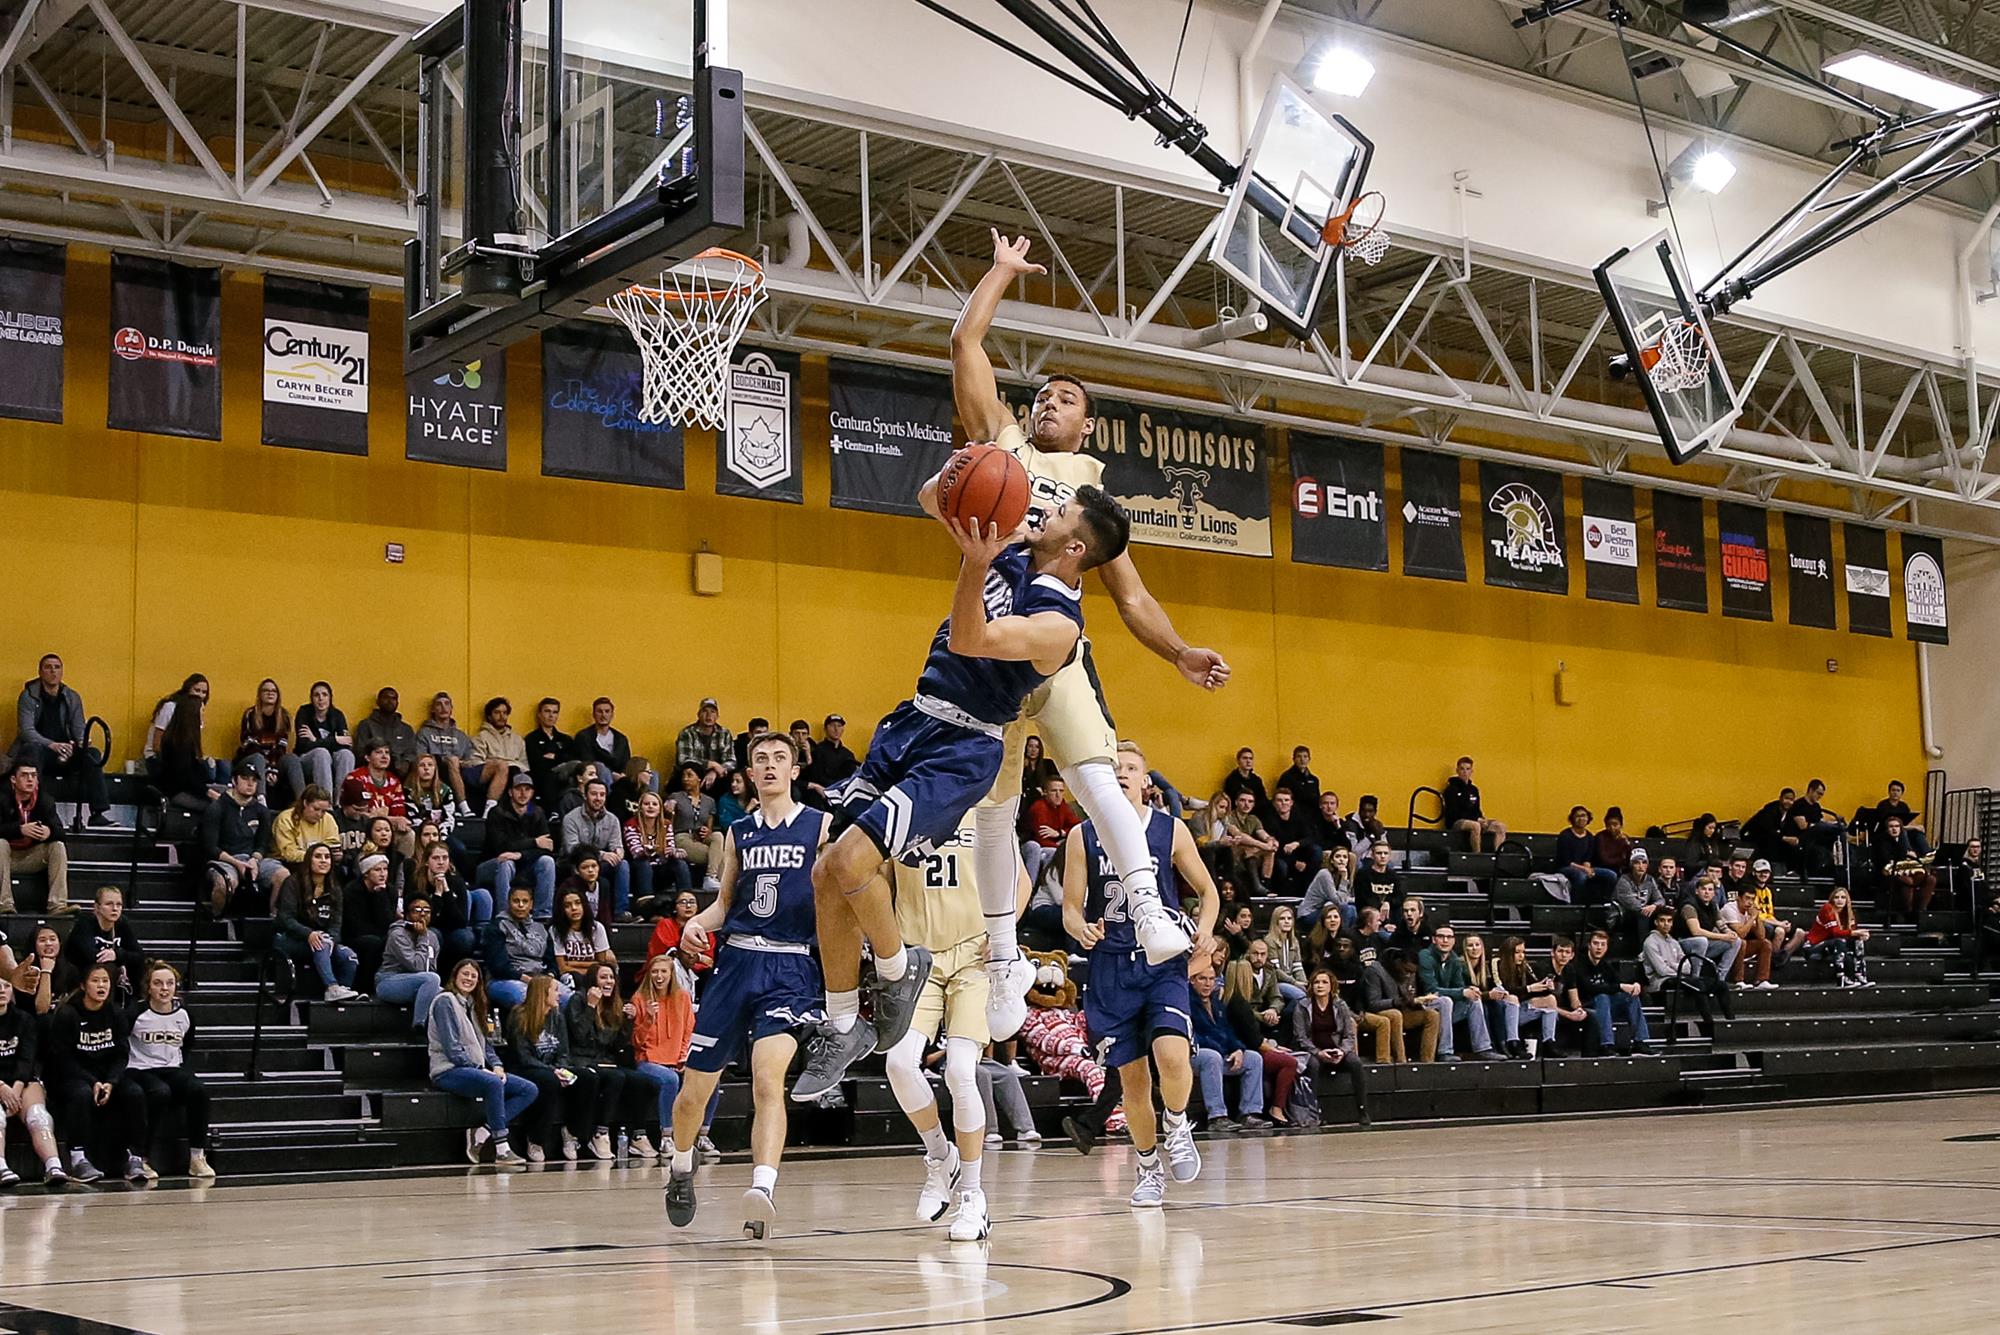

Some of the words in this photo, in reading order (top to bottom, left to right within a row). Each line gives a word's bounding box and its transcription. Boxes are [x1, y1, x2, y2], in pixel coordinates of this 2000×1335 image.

[0, 310, 61, 333] ALIBER
[20, 330, 63, 345] LOANS
[149, 337, 172, 350] D.P.
[177, 341, 213, 357] Dough
[265, 326, 350, 364] Century
[342, 357, 364, 385] 21
[735, 374, 782, 391] SOCCERHAUS
[277, 379, 311, 392] CARYN
[315, 384, 354, 398] BECKER
[409, 395, 503, 426] HYATT
[550, 391, 617, 416] Colorado
[423, 422, 493, 445] PLACE
[830, 411, 872, 433] Centura
[872, 417, 905, 439] Sports
[907, 421, 952, 443] Medicine
[843, 440, 874, 453] Centura
[1139, 412, 1256, 473] Sponsors
[1327, 485, 1379, 523] Ent
[1125, 508, 1178, 529] ountain
[1201, 514, 1237, 536] Lions
[1610, 524, 1627, 536] Best
[1179, 531, 1211, 543] Colorado
[1212, 536, 1238, 548] Springs
[1490, 539, 1520, 562] THE
[1604, 533, 1634, 548] Western
[1610, 546, 1630, 558] PLUS
[1723, 555, 1767, 582] GUARD
[1907, 583, 1944, 608] EMPIRE
[742, 845, 805, 872] MINES
[925, 852, 960, 889] 21
[748, 873, 781, 918] 5
[141, 1031, 184, 1047] UCCS
